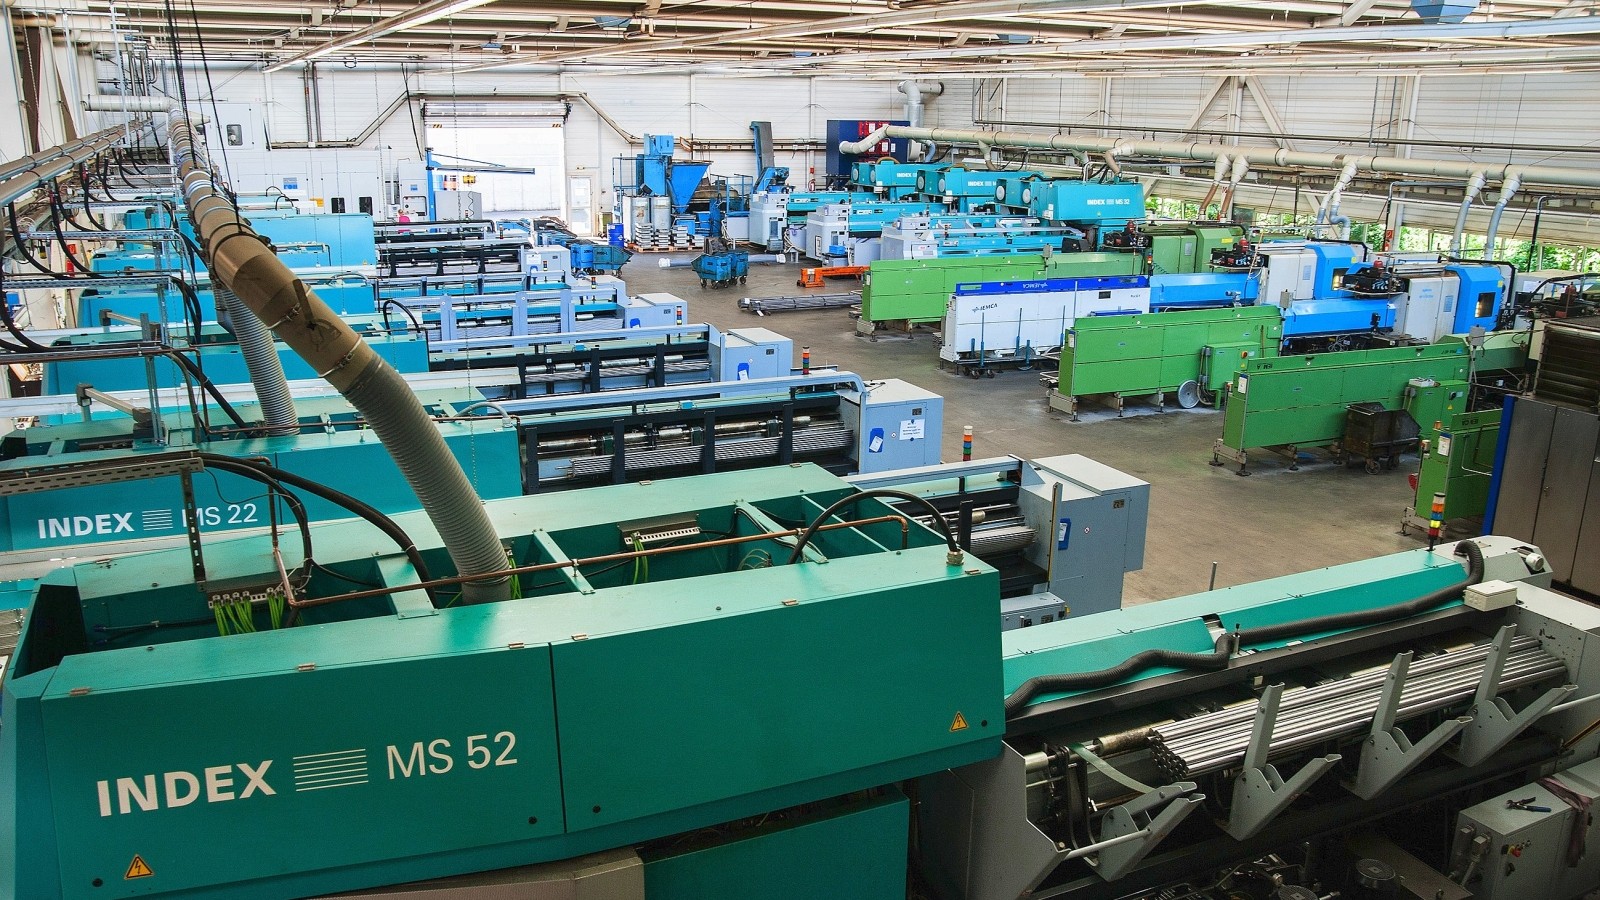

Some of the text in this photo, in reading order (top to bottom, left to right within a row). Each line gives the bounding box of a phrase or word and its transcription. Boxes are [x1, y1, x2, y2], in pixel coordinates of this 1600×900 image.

[979, 303, 998, 311] IEMCA
[38, 503, 258, 539] INDEX MS 22
[96, 731, 519, 818] INDEX MS 52
